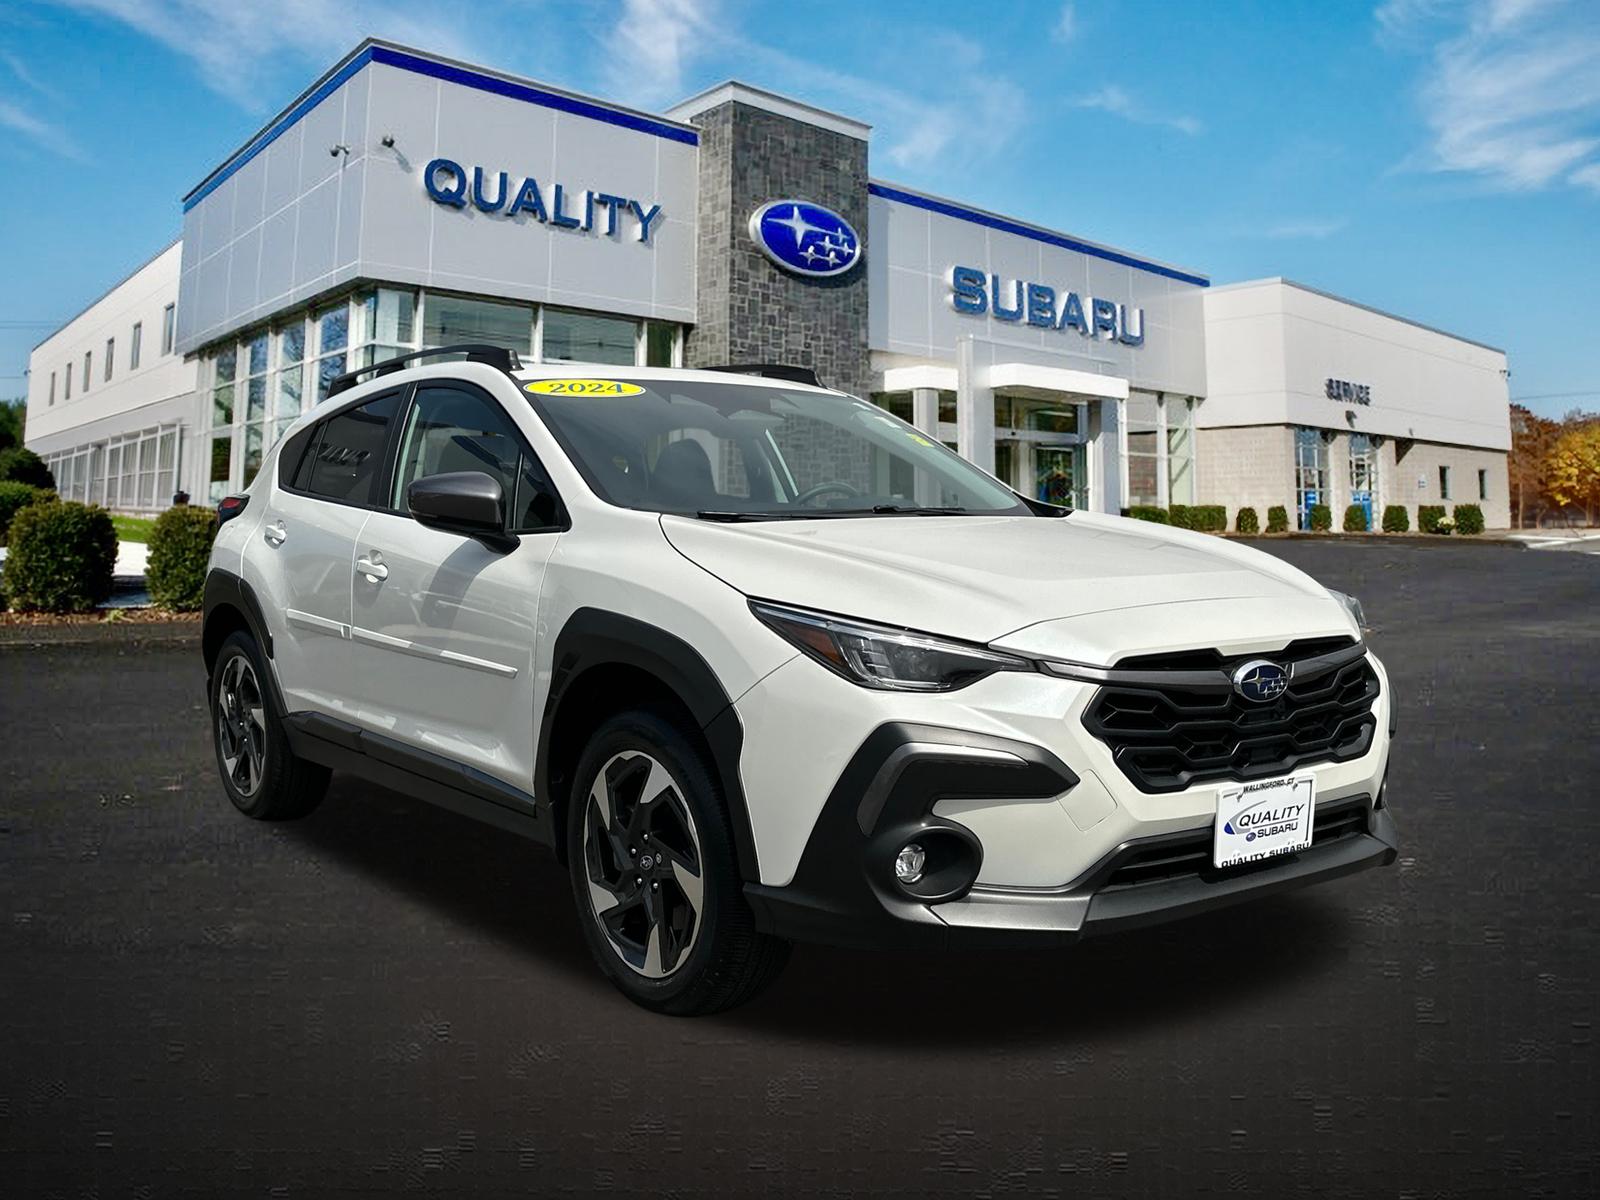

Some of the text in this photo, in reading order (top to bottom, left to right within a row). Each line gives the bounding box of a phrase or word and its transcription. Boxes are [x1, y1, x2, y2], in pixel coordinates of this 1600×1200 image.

[424, 158, 662, 243] QUALITY
[952, 265, 1145, 347] SUBARU
[548, 383, 624, 394] 2024
[1239, 804, 1305, 828] QUALITY
[1257, 821, 1299, 838] SUBARU
[1221, 842, 1310, 868] QUALITY SUBARU
